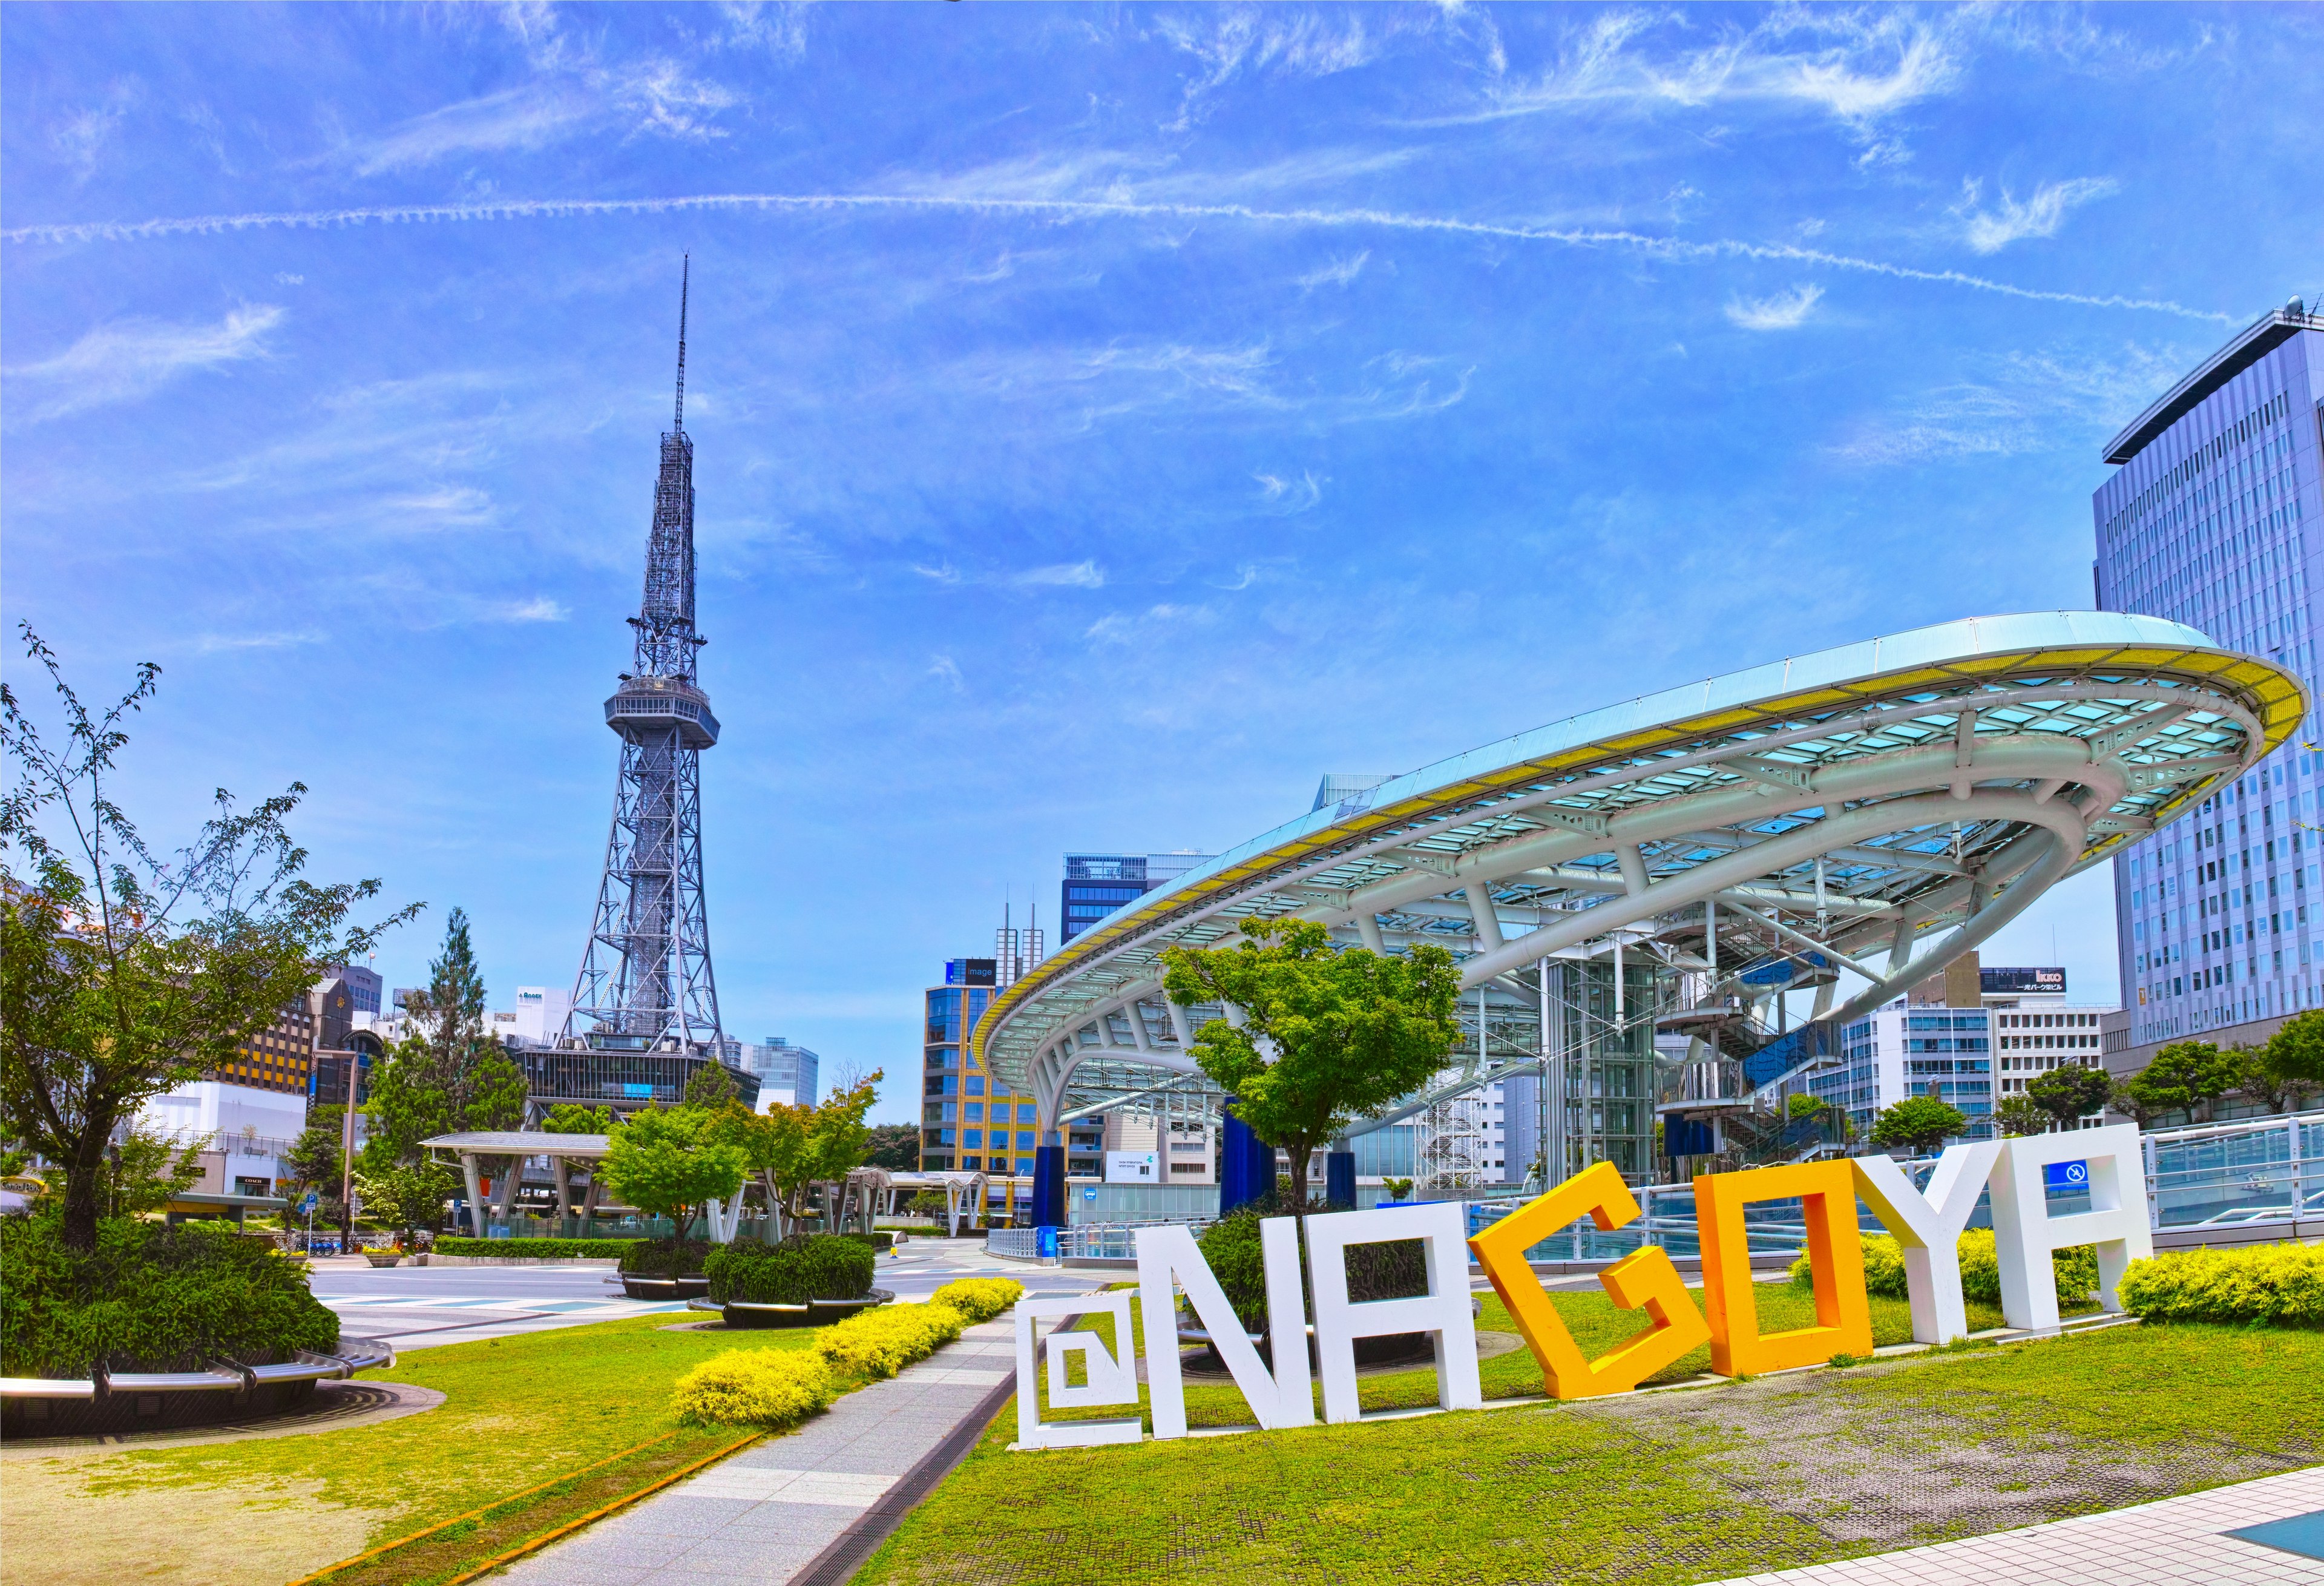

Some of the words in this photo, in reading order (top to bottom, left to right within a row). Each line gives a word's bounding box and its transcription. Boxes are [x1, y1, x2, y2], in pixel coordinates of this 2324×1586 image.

[968, 967, 992, 977] Image
[1, 1181, 24, 1190] Central
[25, 1183, 40, 1191] Park
